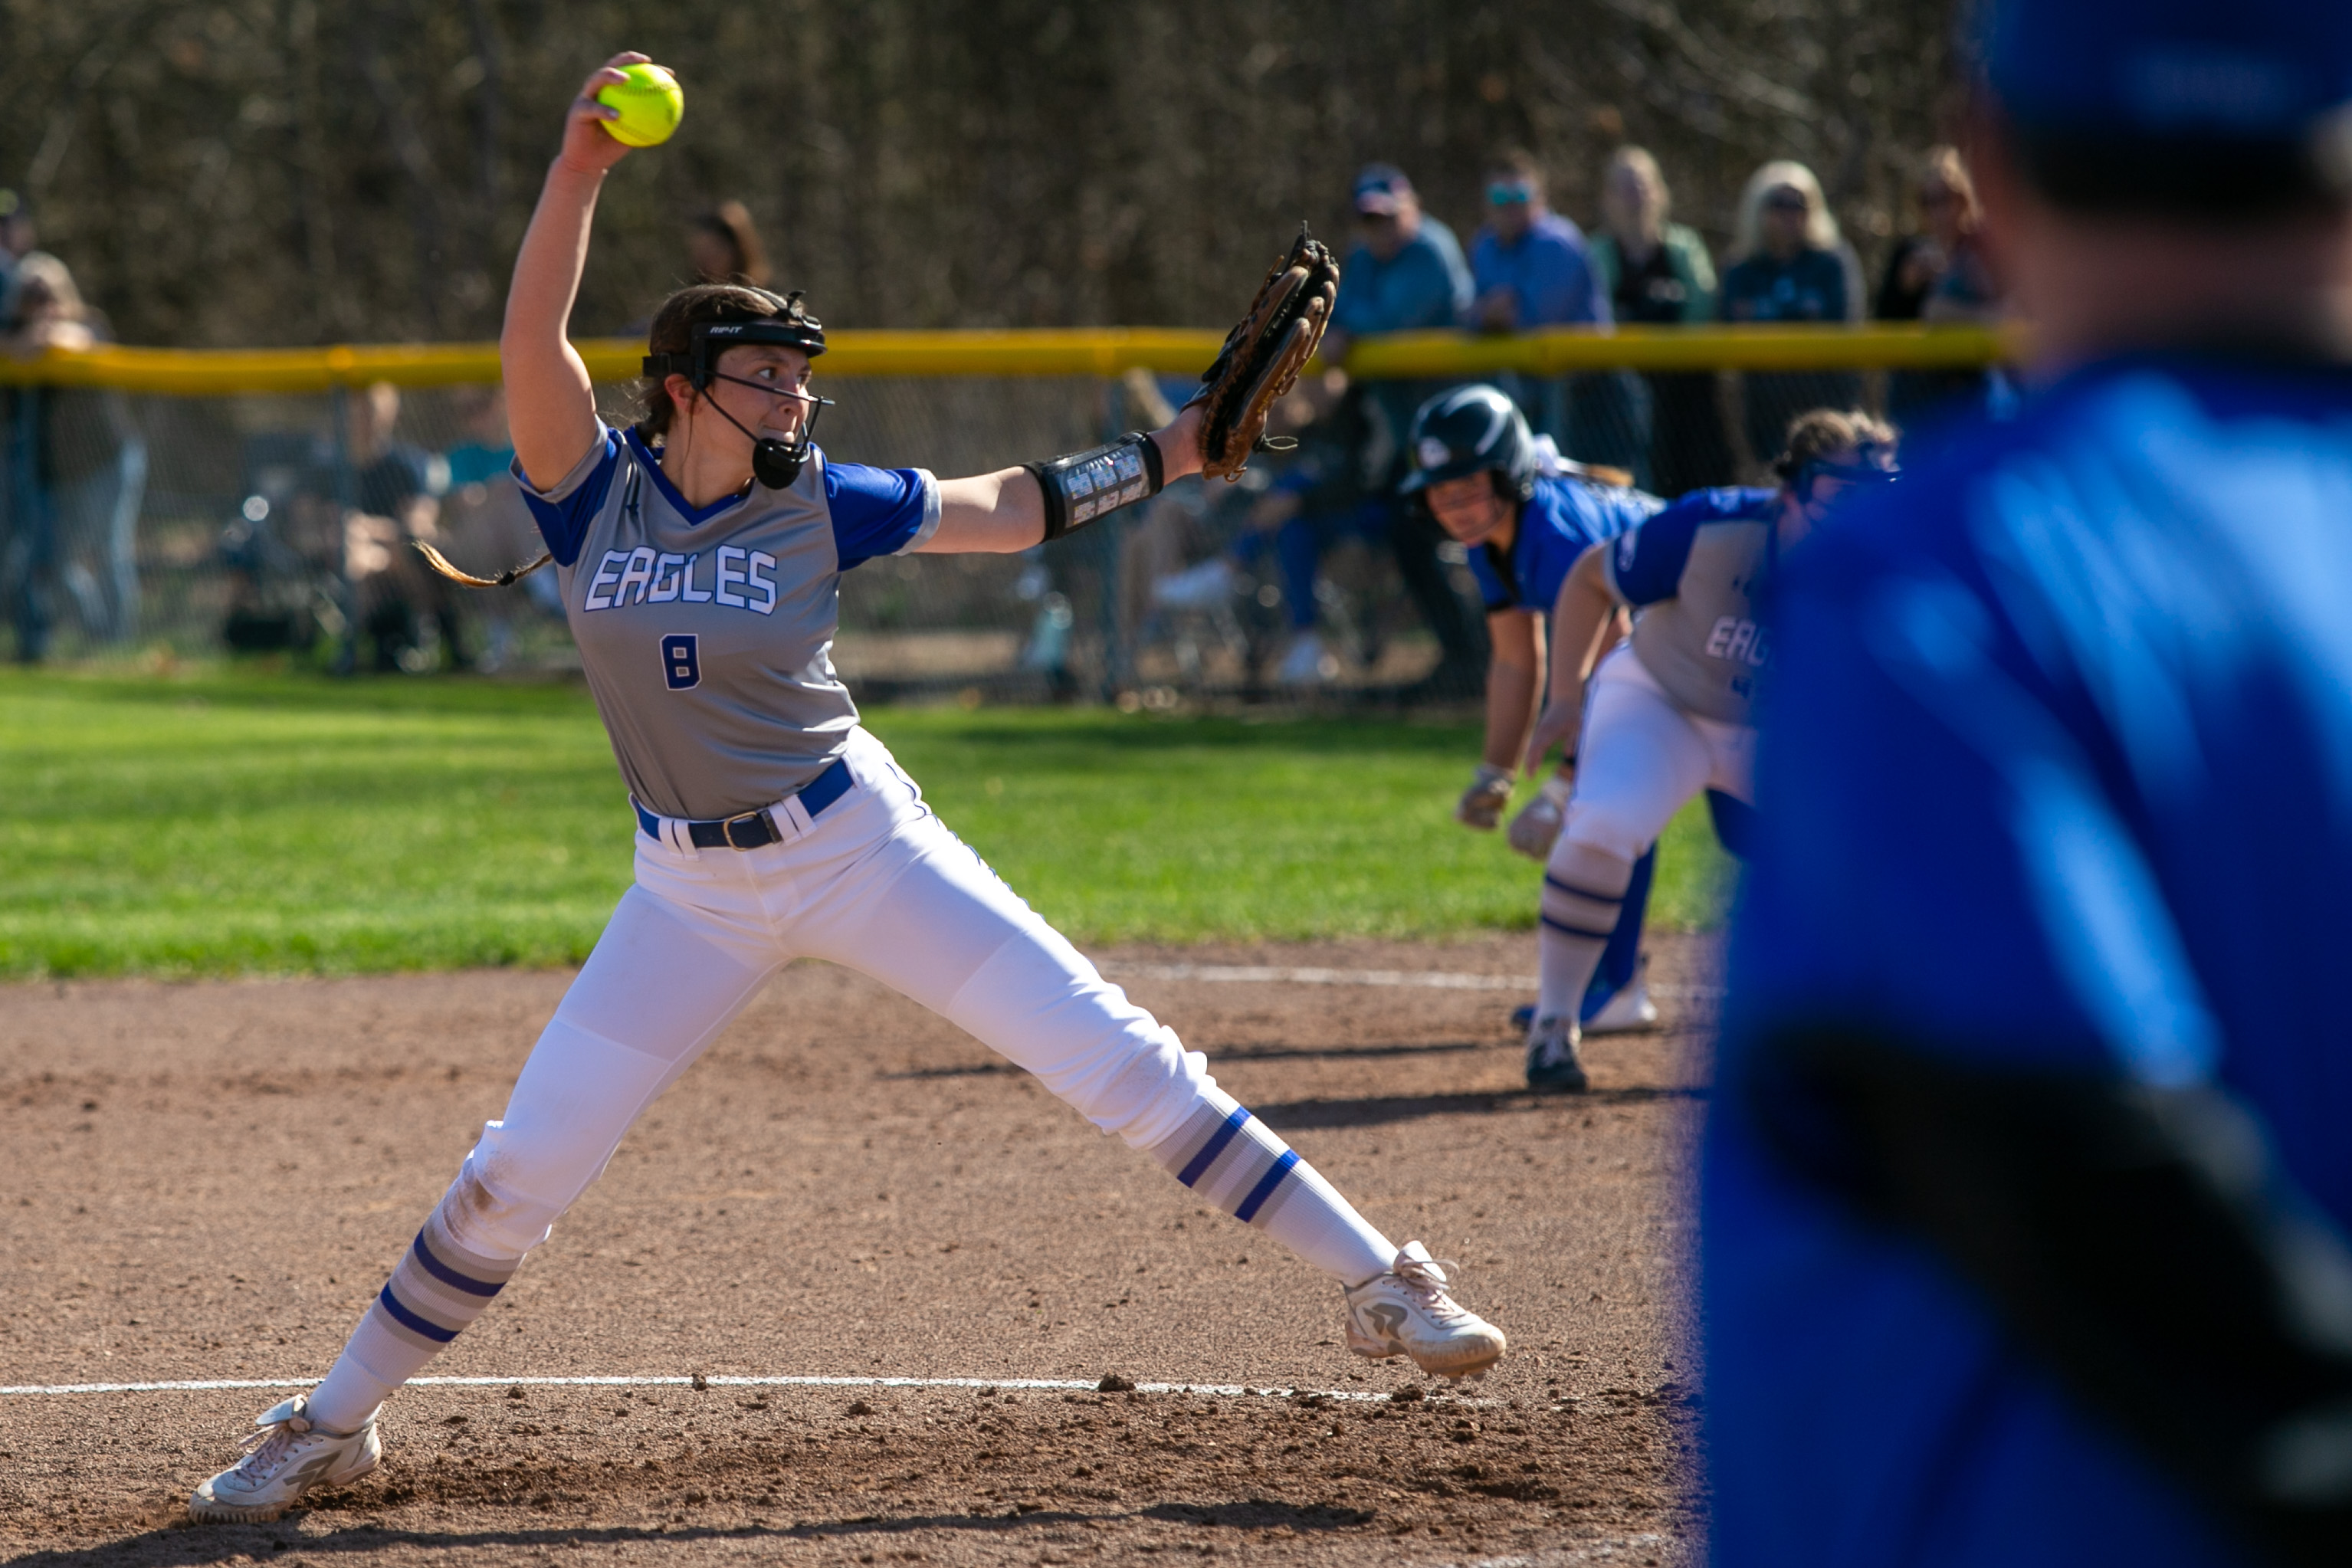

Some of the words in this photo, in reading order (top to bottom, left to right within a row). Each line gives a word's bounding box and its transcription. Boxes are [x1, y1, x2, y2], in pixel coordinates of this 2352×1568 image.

[584, 545, 777, 616] EAGLES
[659, 633, 702, 691] 8
[1706, 615, 1770, 667] EAG
